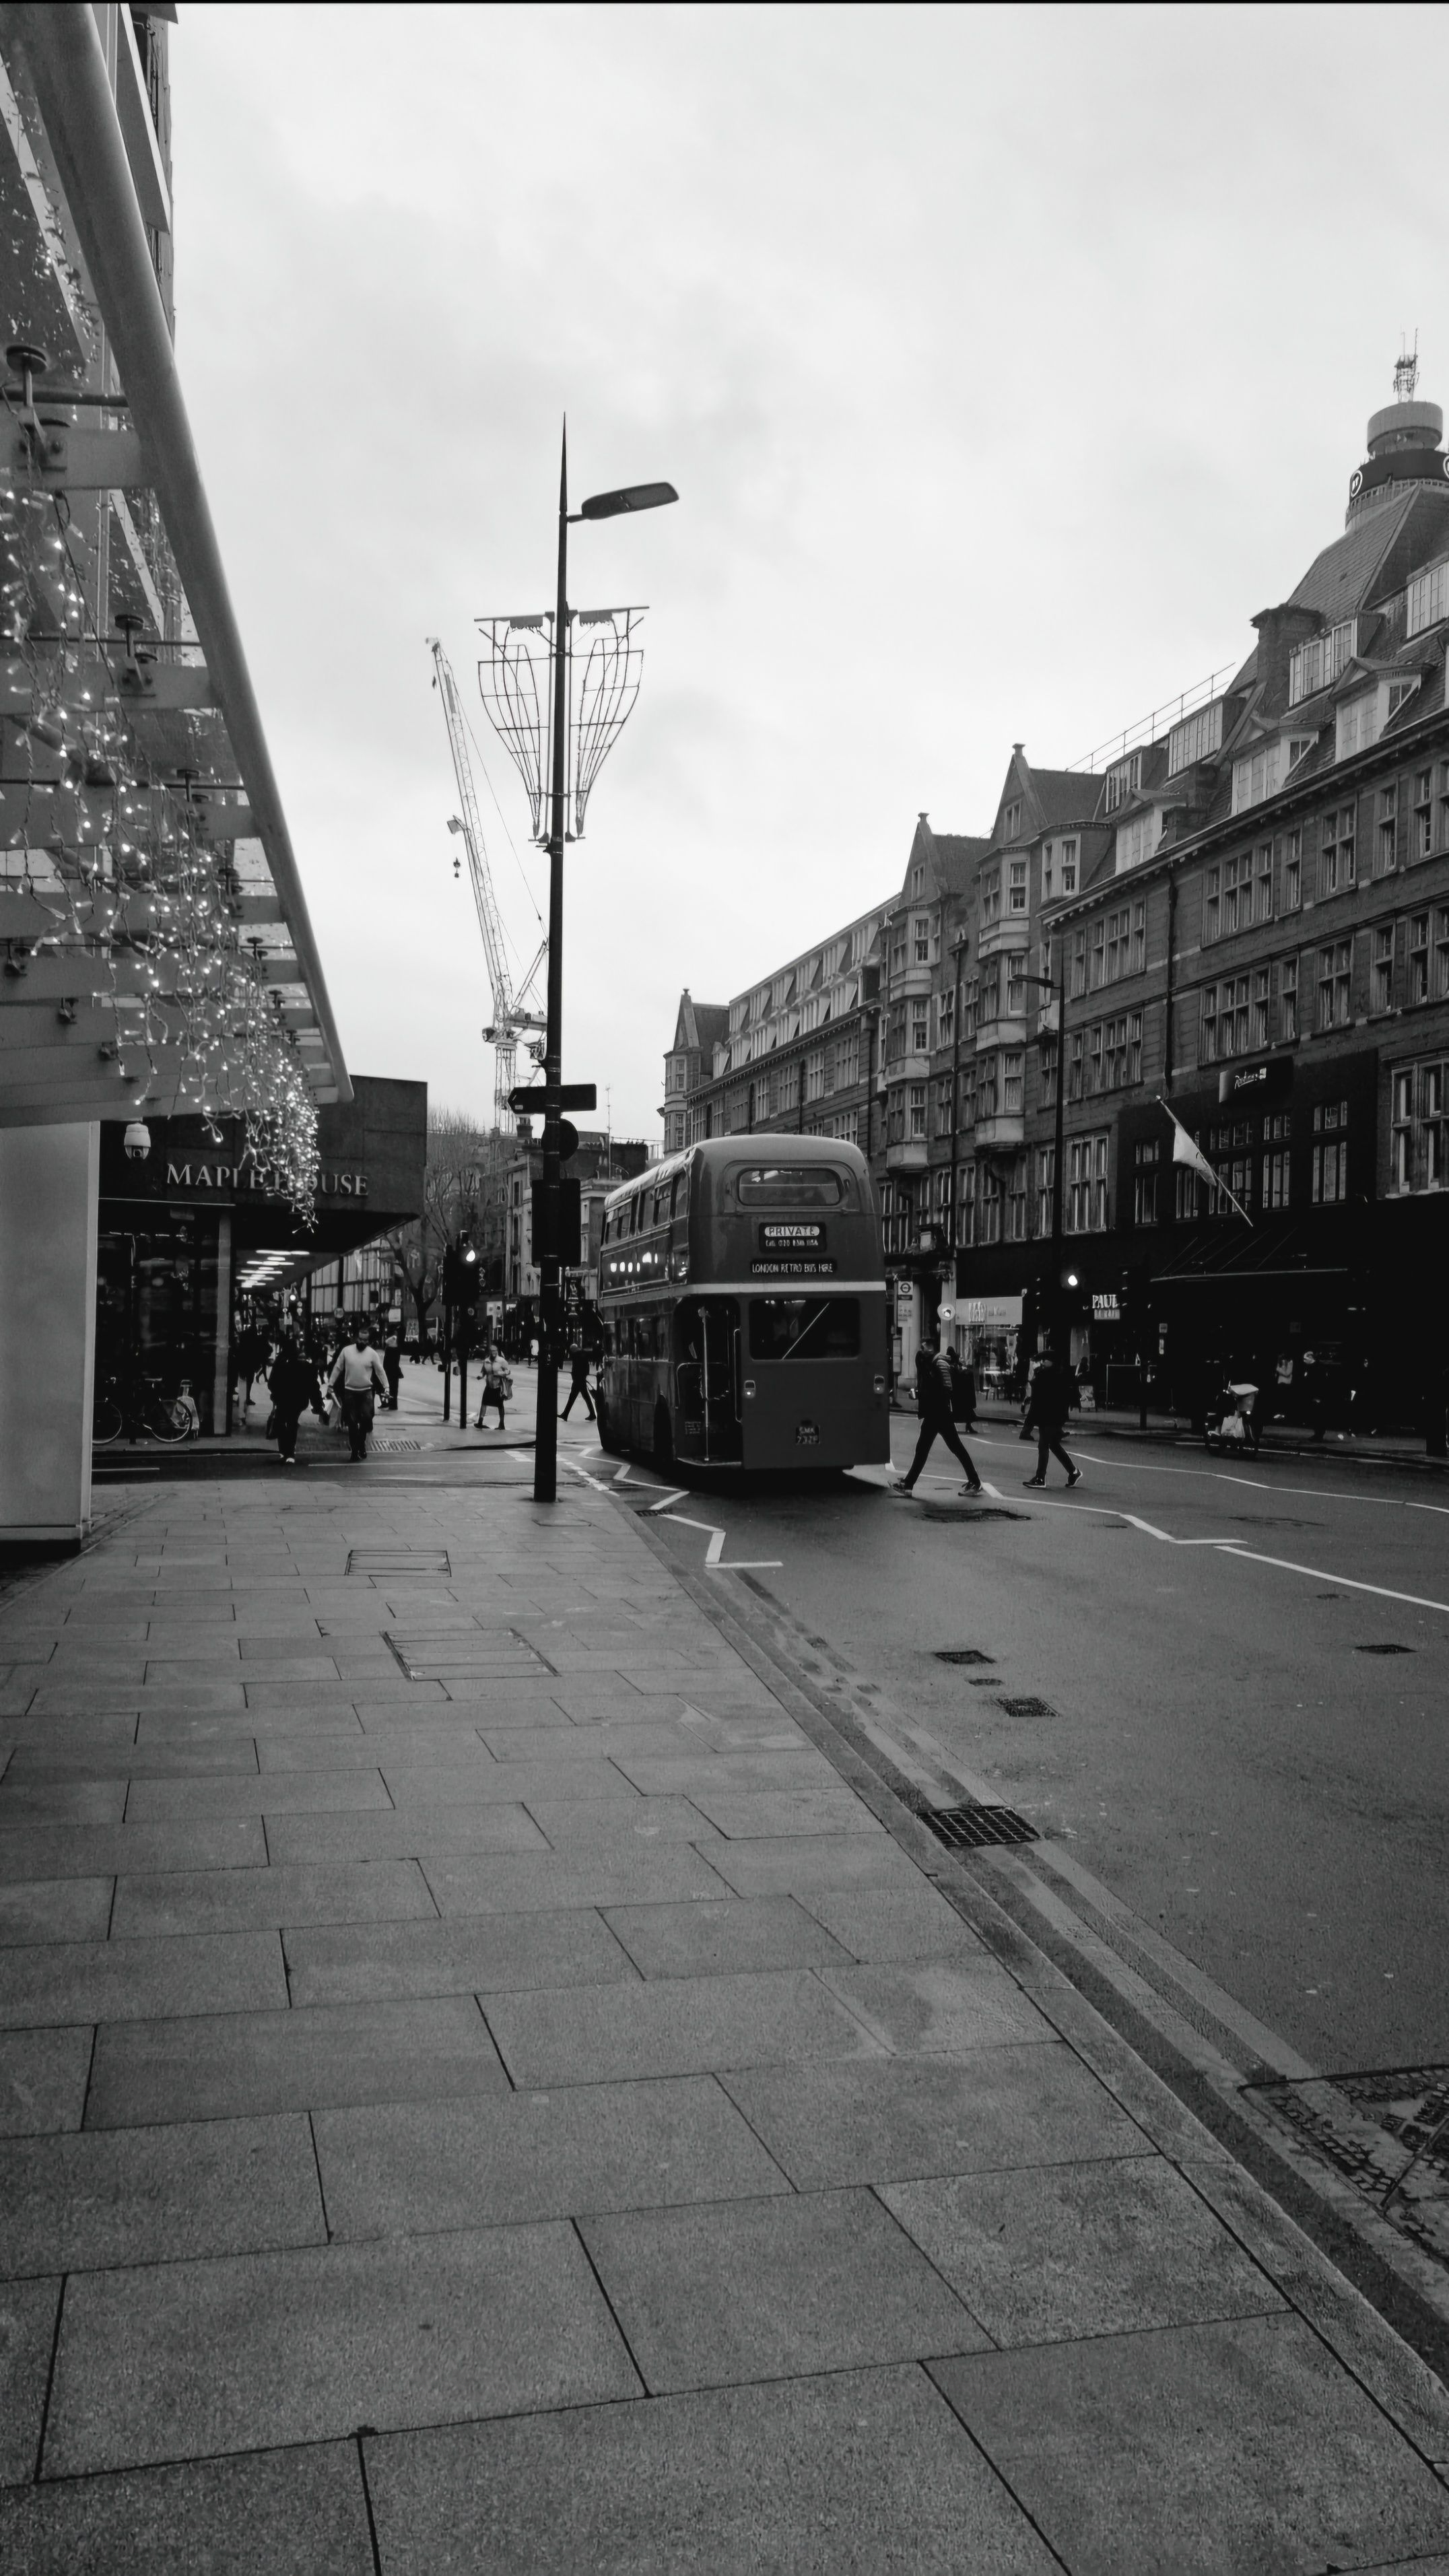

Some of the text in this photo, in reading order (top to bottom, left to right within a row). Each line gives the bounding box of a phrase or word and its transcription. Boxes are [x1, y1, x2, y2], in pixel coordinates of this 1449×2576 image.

[167, 1163, 268, 1189] MAPLE
[769, 1227, 815, 1235] PRIVATE
[752, 1264, 779, 1273] LONDON
[781, 1263, 802, 1273] RETRO
[804, 1264, 816, 1273] BUS
[1092, 1294, 1119, 1308] PAUL
